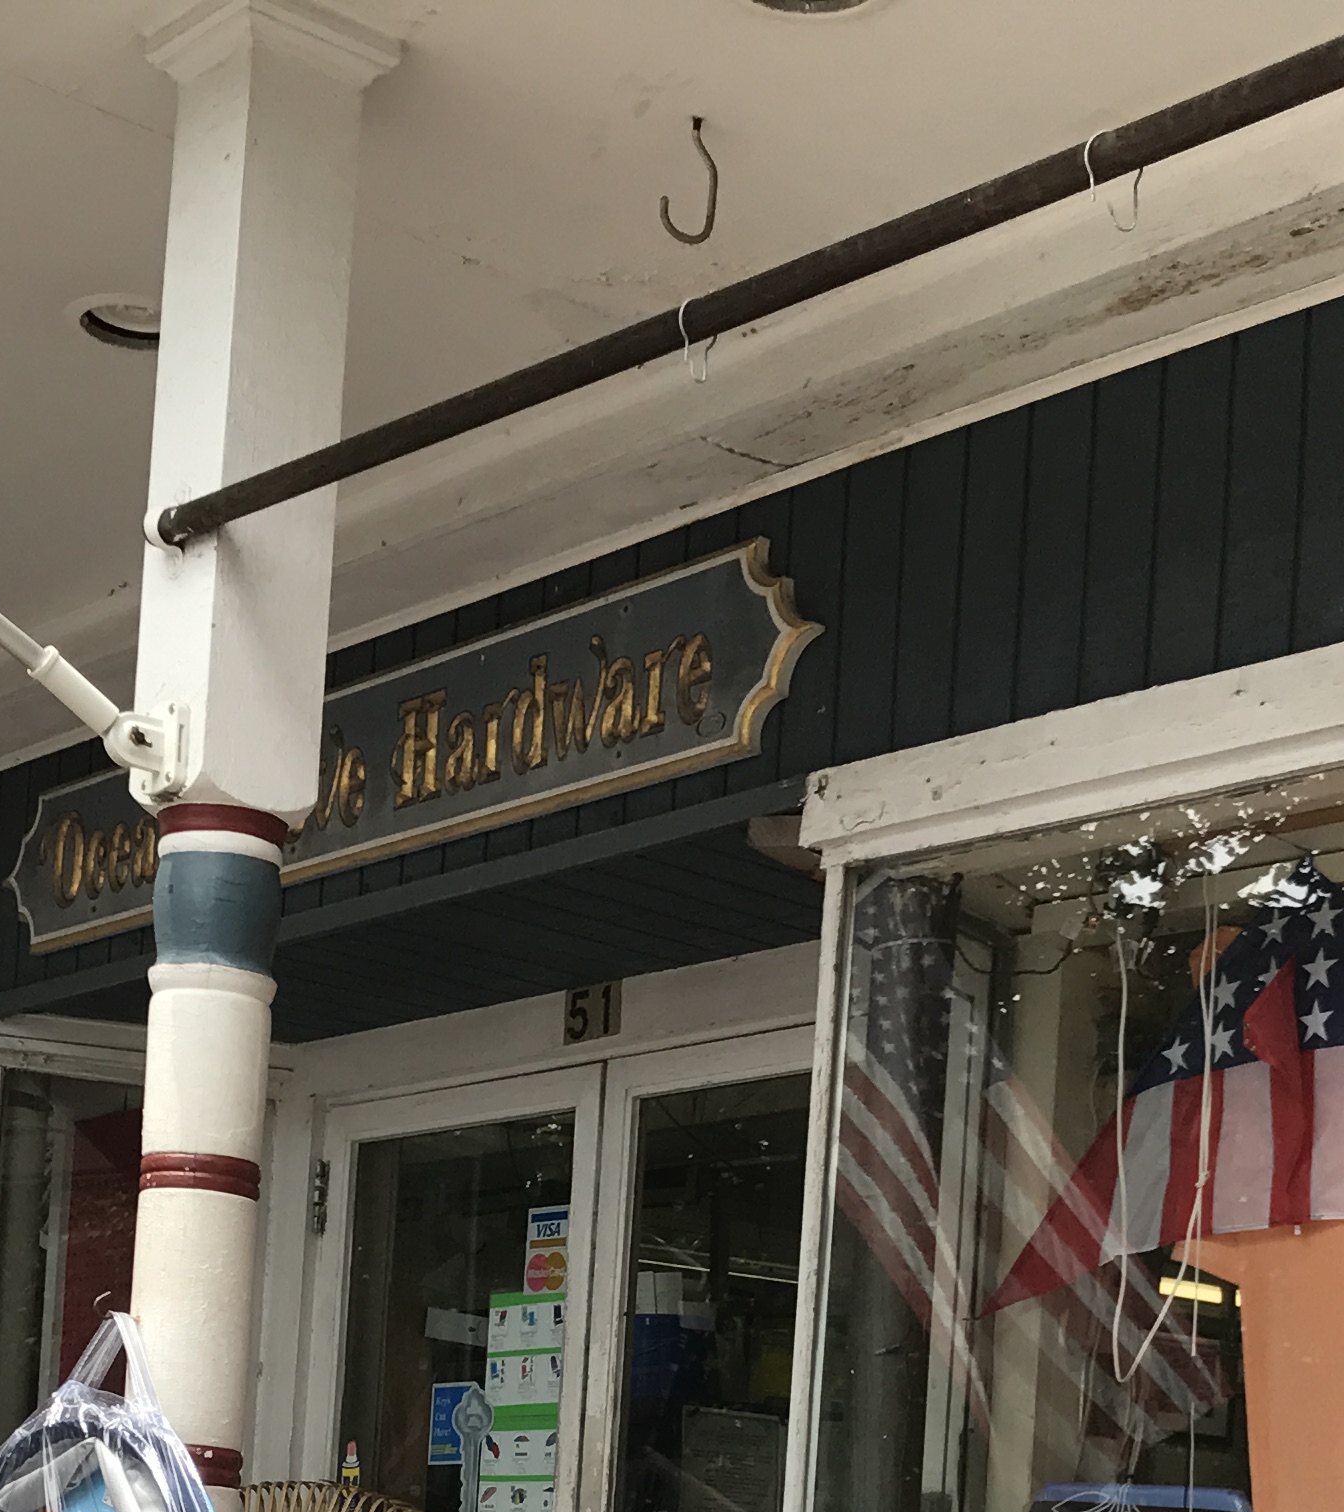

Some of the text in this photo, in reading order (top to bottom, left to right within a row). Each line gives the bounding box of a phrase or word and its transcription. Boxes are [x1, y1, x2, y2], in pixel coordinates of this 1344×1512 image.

[39, 808, 159, 909] Ocea
[392, 634, 714, 810] Hardware
[567, 985, 612, 1040] 51
[536, 1222, 561, 1238] VISA
